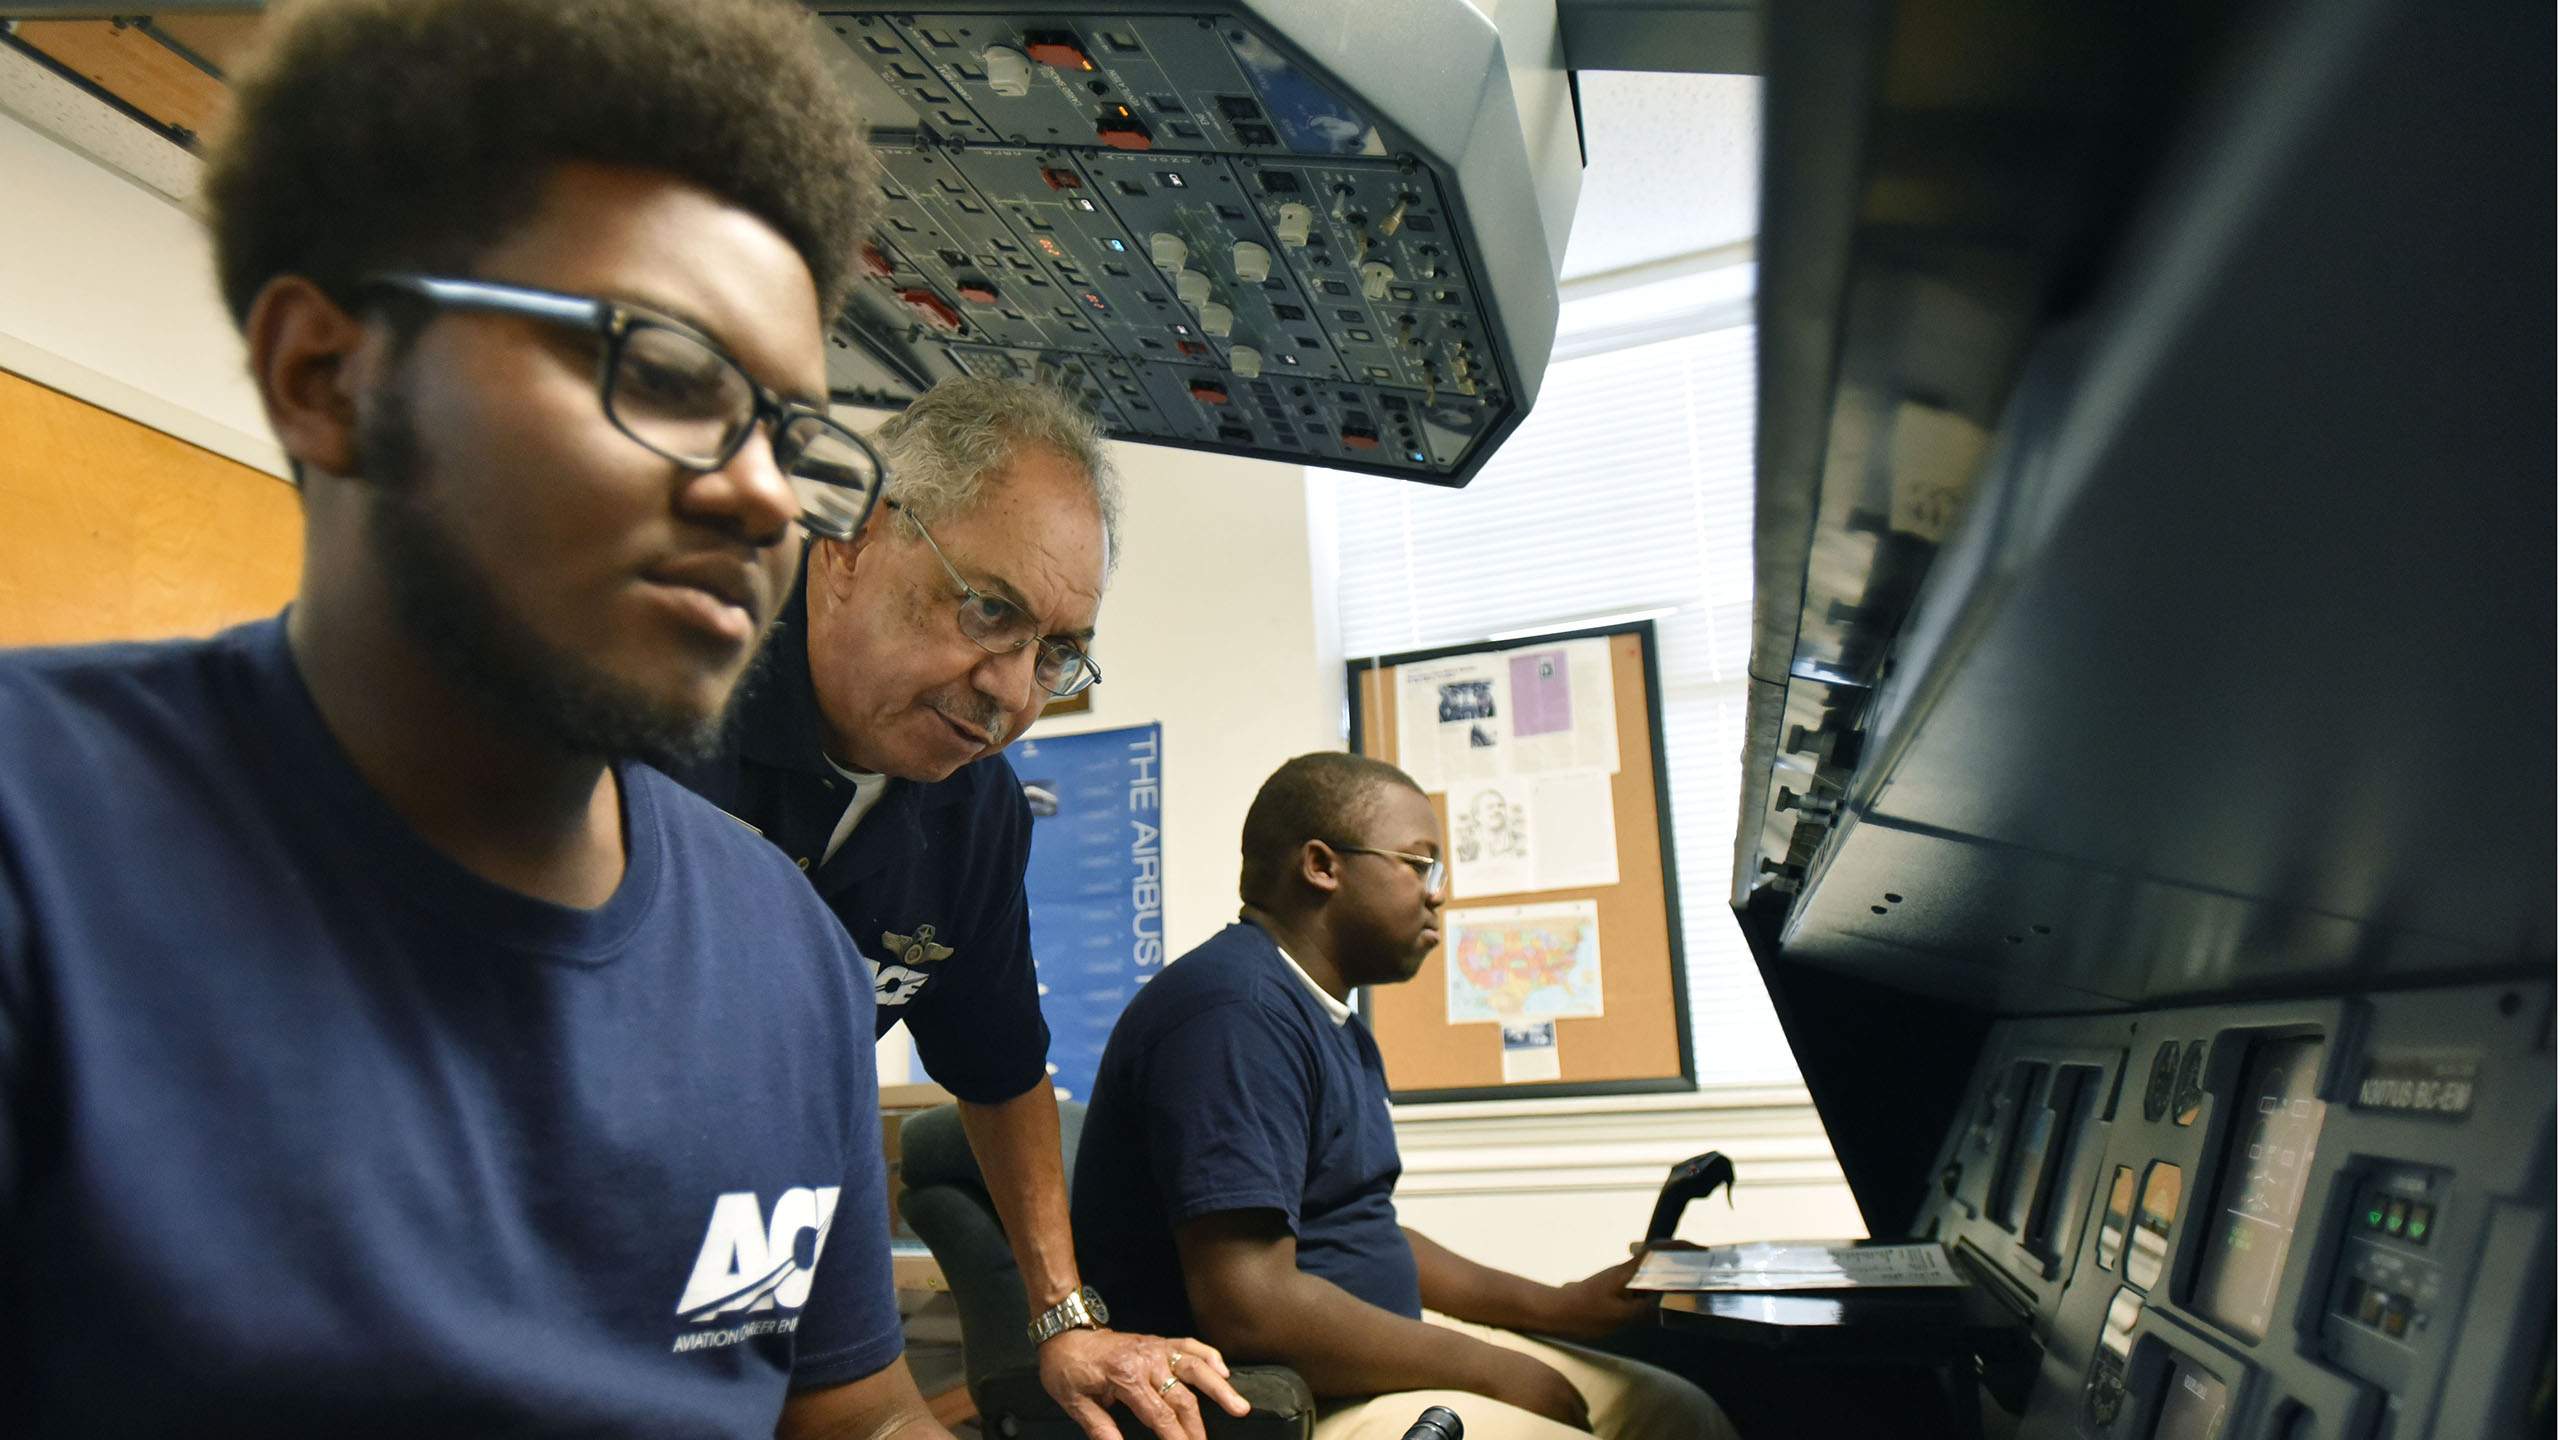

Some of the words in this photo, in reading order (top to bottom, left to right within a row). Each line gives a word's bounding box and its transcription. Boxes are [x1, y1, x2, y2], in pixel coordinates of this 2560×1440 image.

[1128, 733, 1158, 810] THE
[1130, 820, 1161, 966] AIRBUS
[673, 1329, 740, 1352] AVIATION
